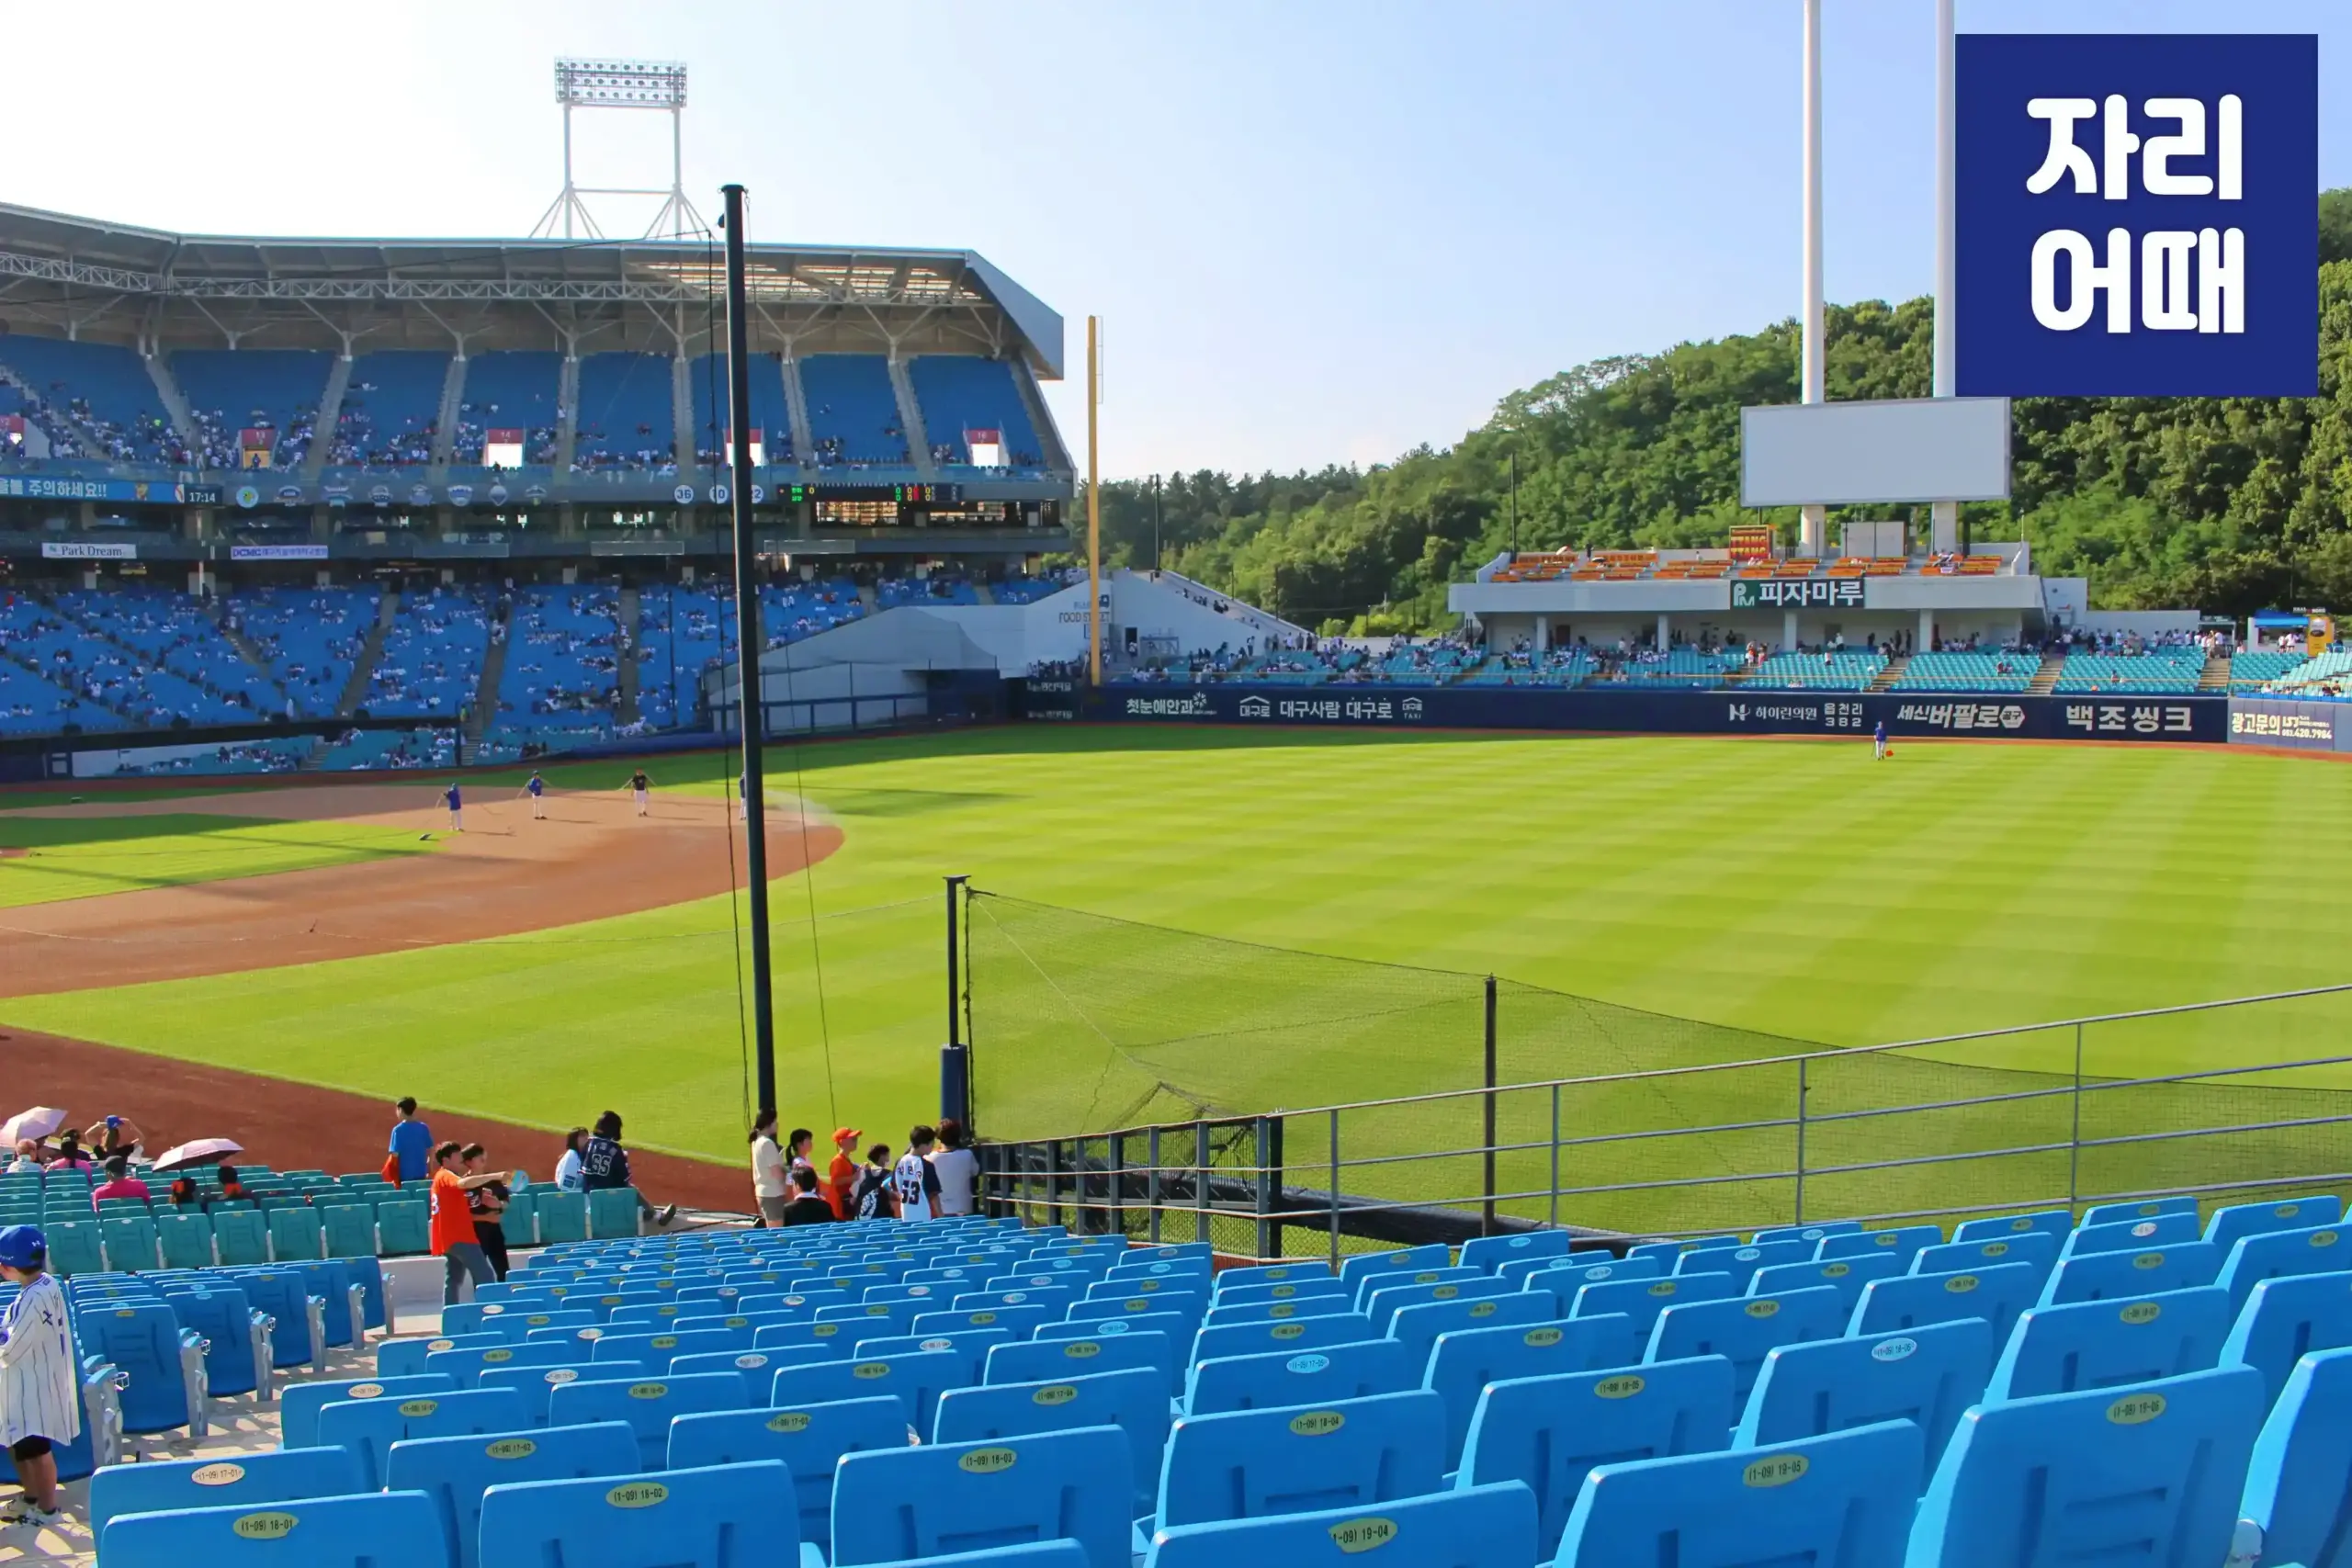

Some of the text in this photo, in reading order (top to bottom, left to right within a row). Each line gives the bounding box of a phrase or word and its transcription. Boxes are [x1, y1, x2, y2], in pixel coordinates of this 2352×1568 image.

[28, 479, 107, 498] 주의하세요!!
[189, 492, 216, 502] 17:14
[62, 546, 122, 556] Park Dream
[1759, 581, 1863, 606] 피자마루
[1126, 698, 1193, 715] 첫눈애안과
[1239, 705, 1271, 717] 대구로
[1280, 701, 1393, 719] 대구사람 대구로
[1756, 706, 1817, 720] 하이린의원
[1825, 717, 1862, 728] 382
[2066, 705, 2192, 733] 백조씽크
[2232, 713, 2280, 736] 광고문의
[901, 1179, 921, 1205] 53
[2113, 1404, 2136, 1418] (1-09)
[1295, 1416, 1340, 1430] (1-09) 18-04
[966, 1452, 1012, 1467] (1-09) 18-03
[198, 1469, 239, 1480] (1-09) 17-01
[1748, 1461, 1802, 1482] (1-09) 19-05
[614, 1487, 663, 1502] (1-09) 18-02
[241, 1518, 294, 1531] (1-09) 18-01
[1362, 1524, 1389, 1540] 19-04
